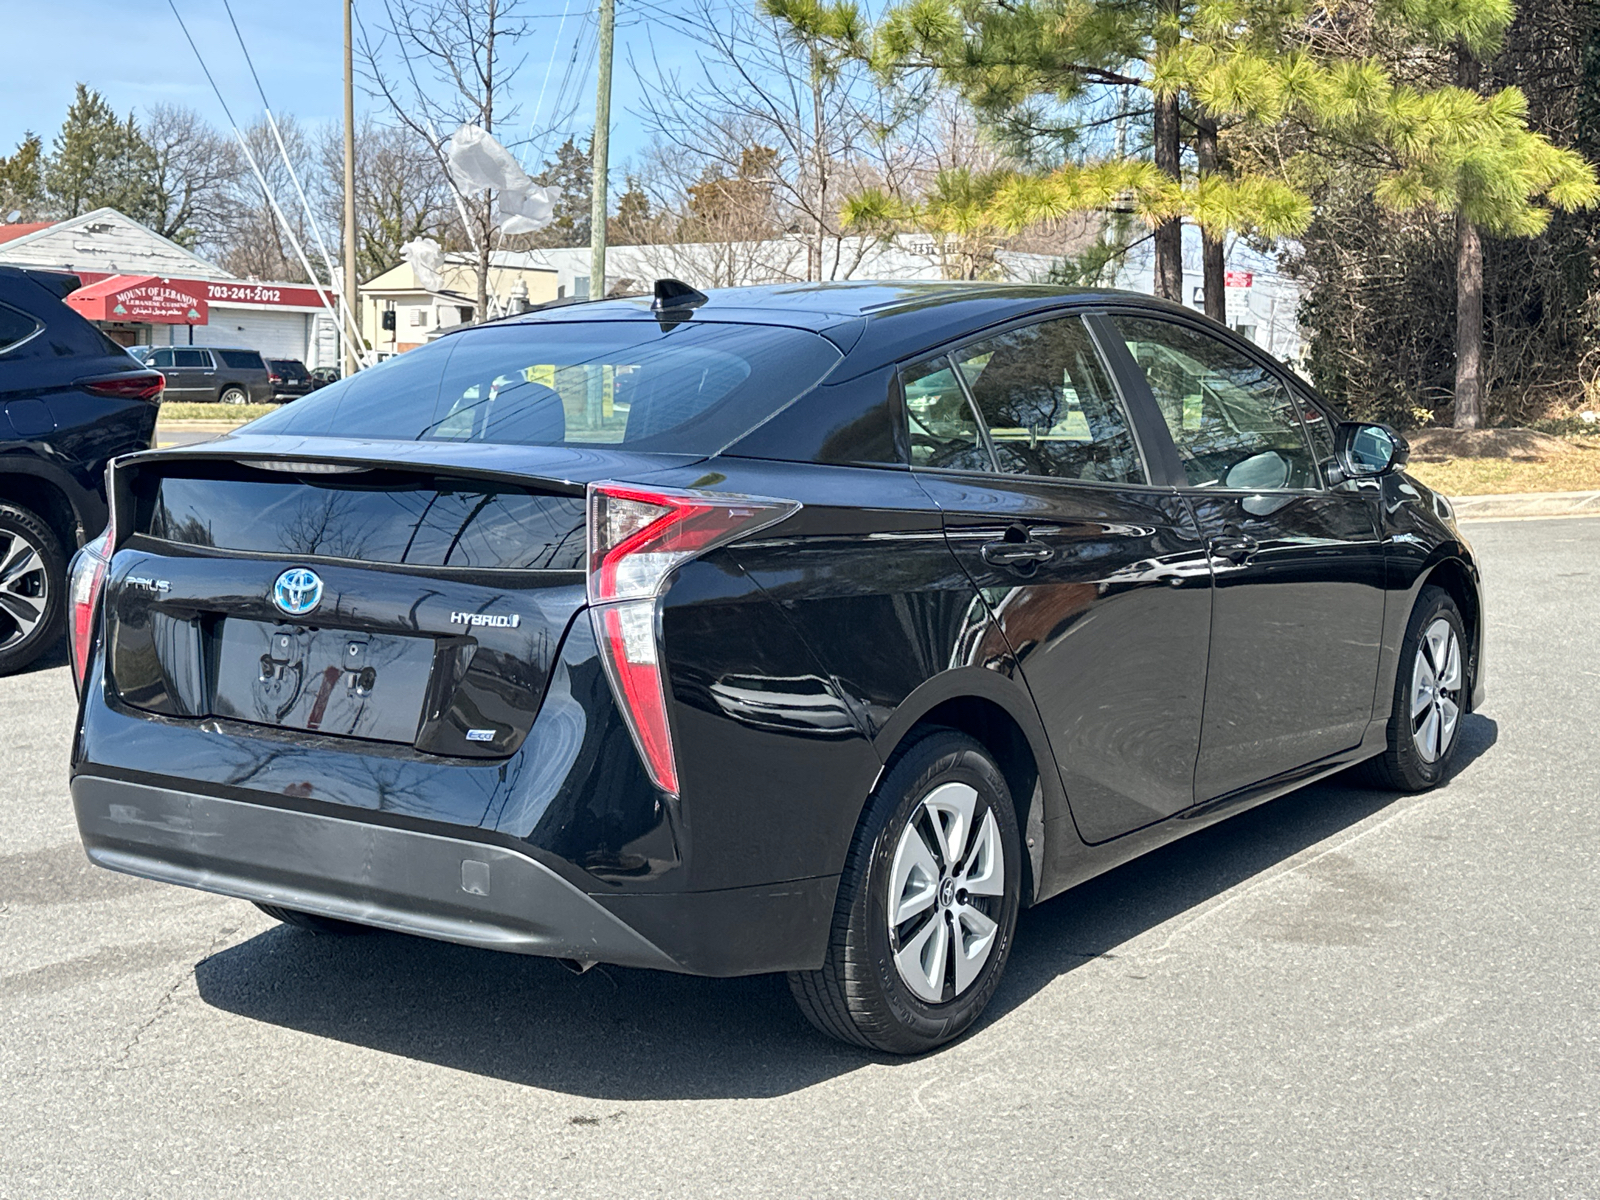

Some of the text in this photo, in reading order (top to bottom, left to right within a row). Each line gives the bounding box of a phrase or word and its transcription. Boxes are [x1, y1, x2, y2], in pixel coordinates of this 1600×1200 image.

[116, 287, 198, 307] MOUNT OF LEBANON
[207, 285, 281, 301] 703-241-2012
[126, 299, 161, 307] LEBANESE
[125, 576, 171, 593] PRIUS
[450, 611, 508, 628] HYBRID
